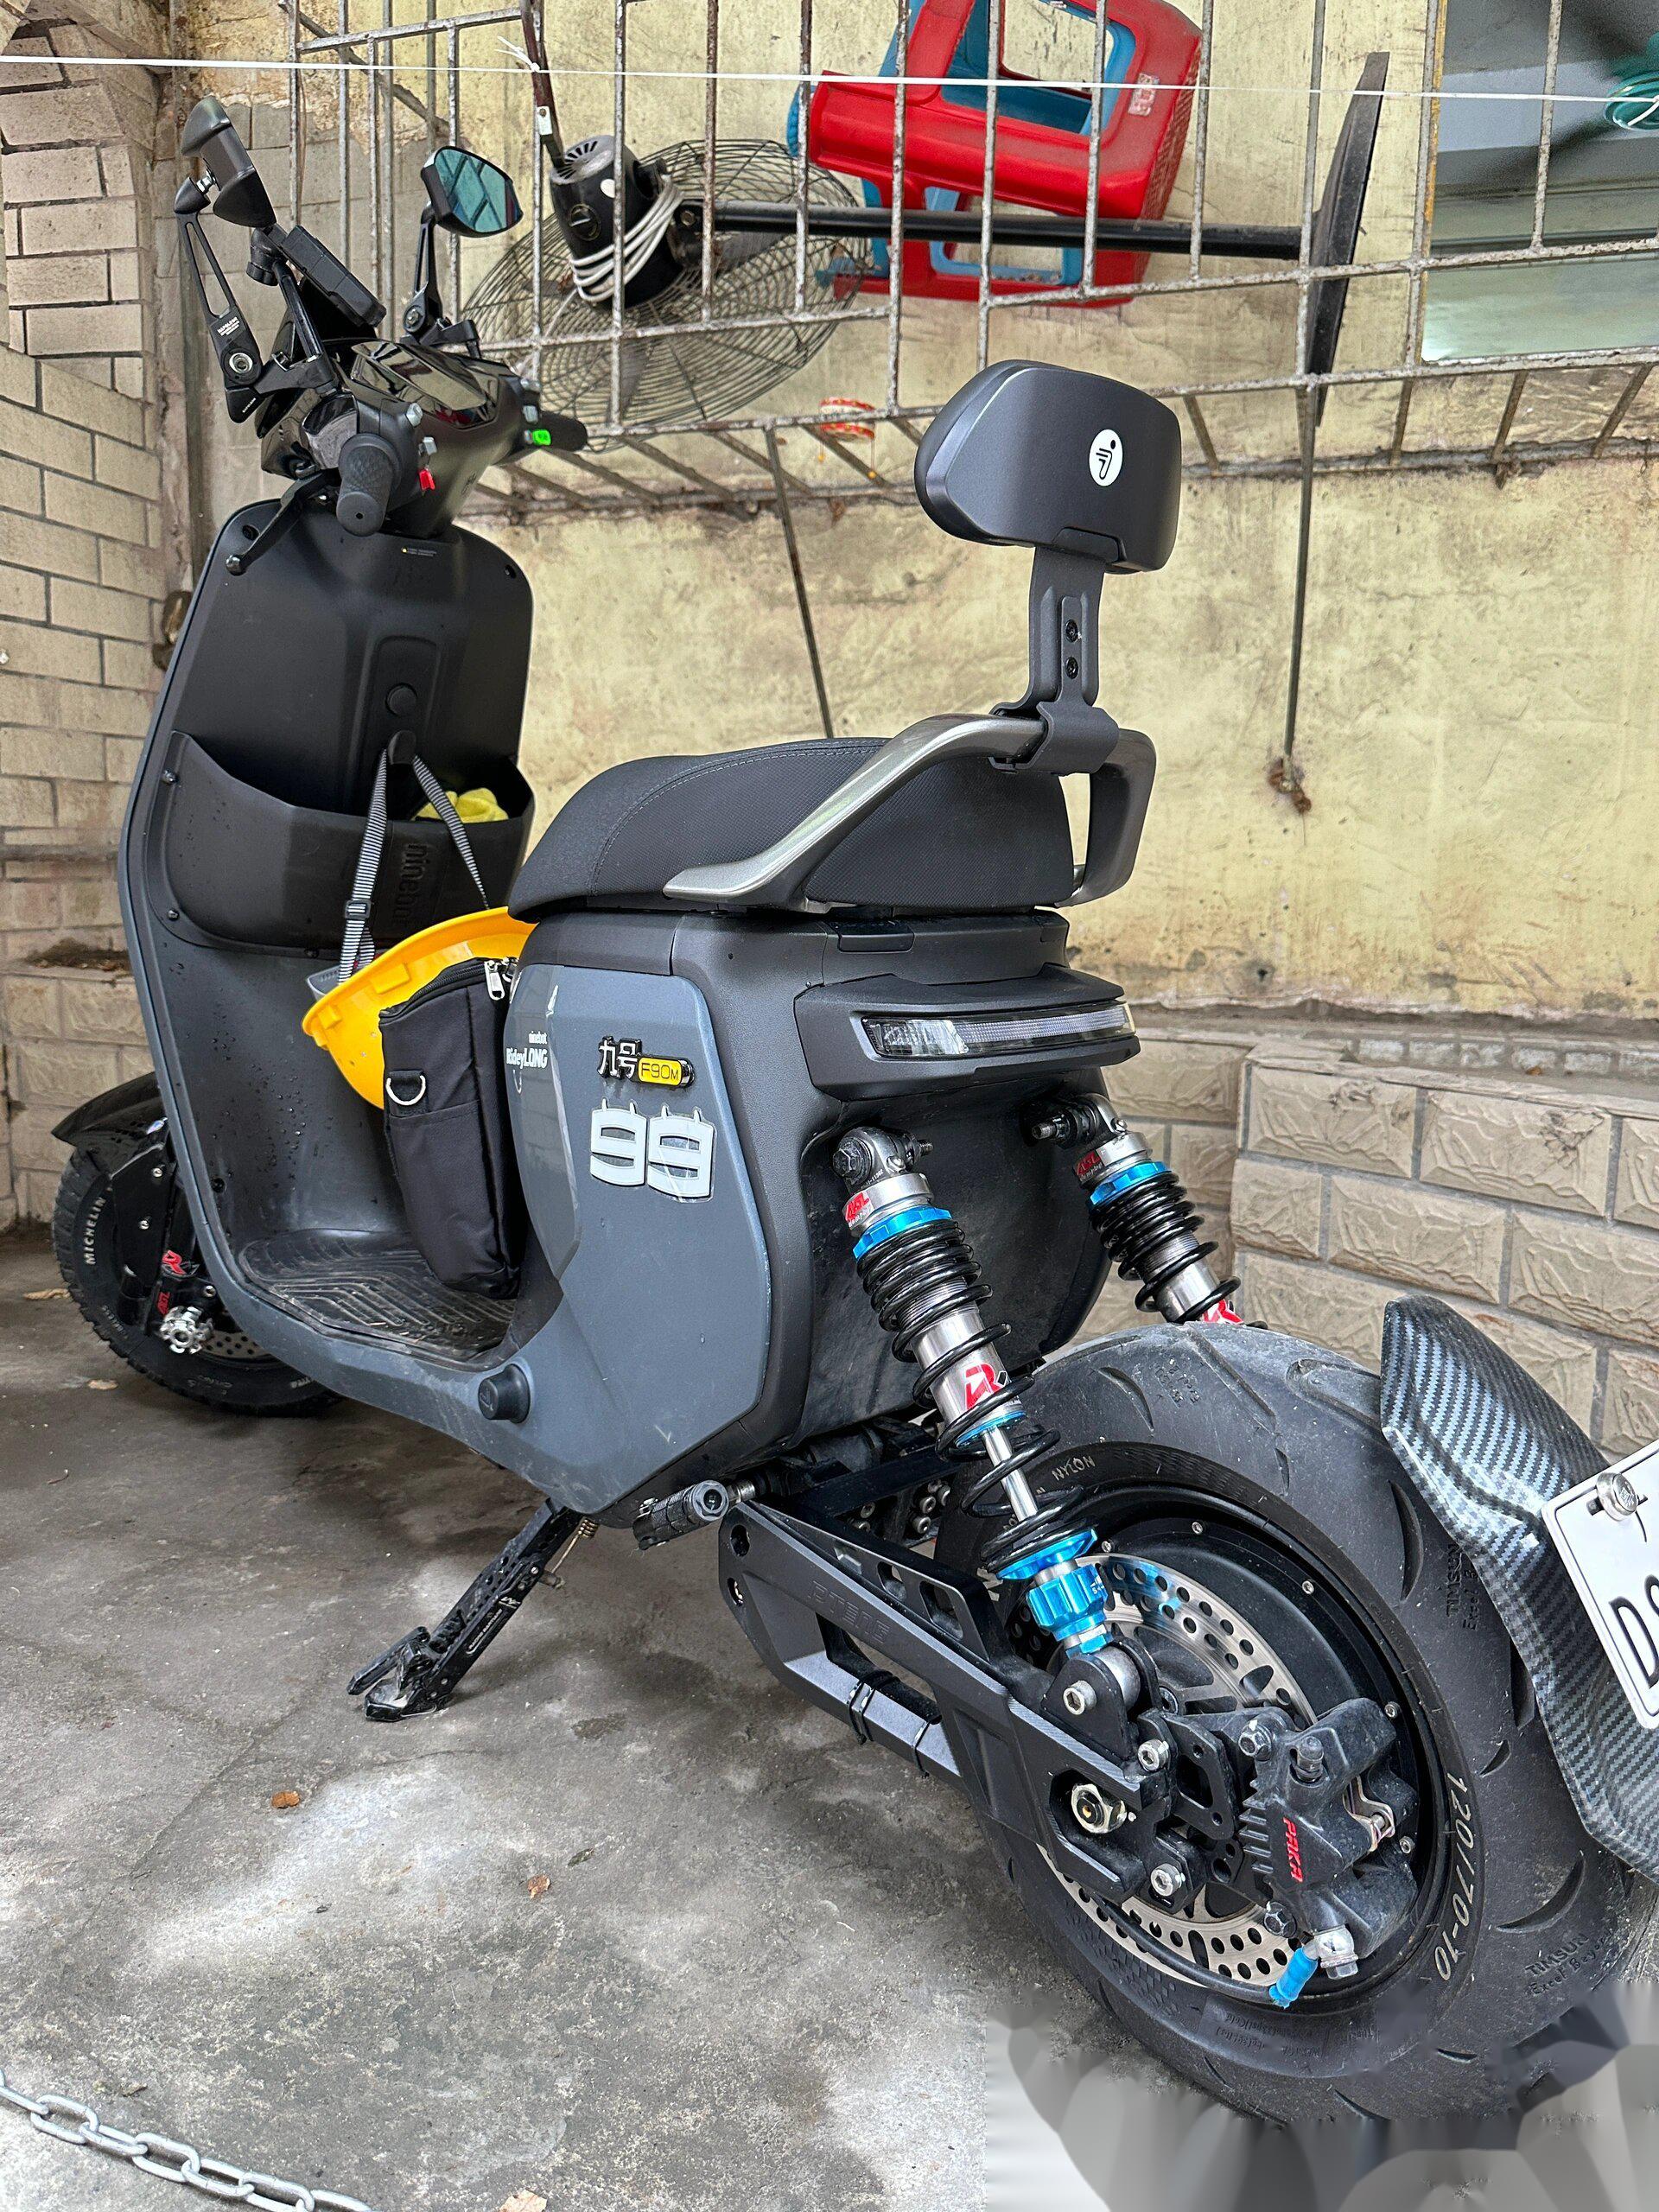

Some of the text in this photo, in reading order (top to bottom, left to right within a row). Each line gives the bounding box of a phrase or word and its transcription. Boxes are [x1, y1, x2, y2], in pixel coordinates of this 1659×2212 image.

[598, 1037, 679, 1081] 九号 F90M
[83, 1197, 107, 1265] MICHELIN
[1052, 1455, 1096, 1481] NYLON
[1434, 1772, 1475, 1980] 120/70-10
[1524, 1932, 1590, 1977] TIMSUN
